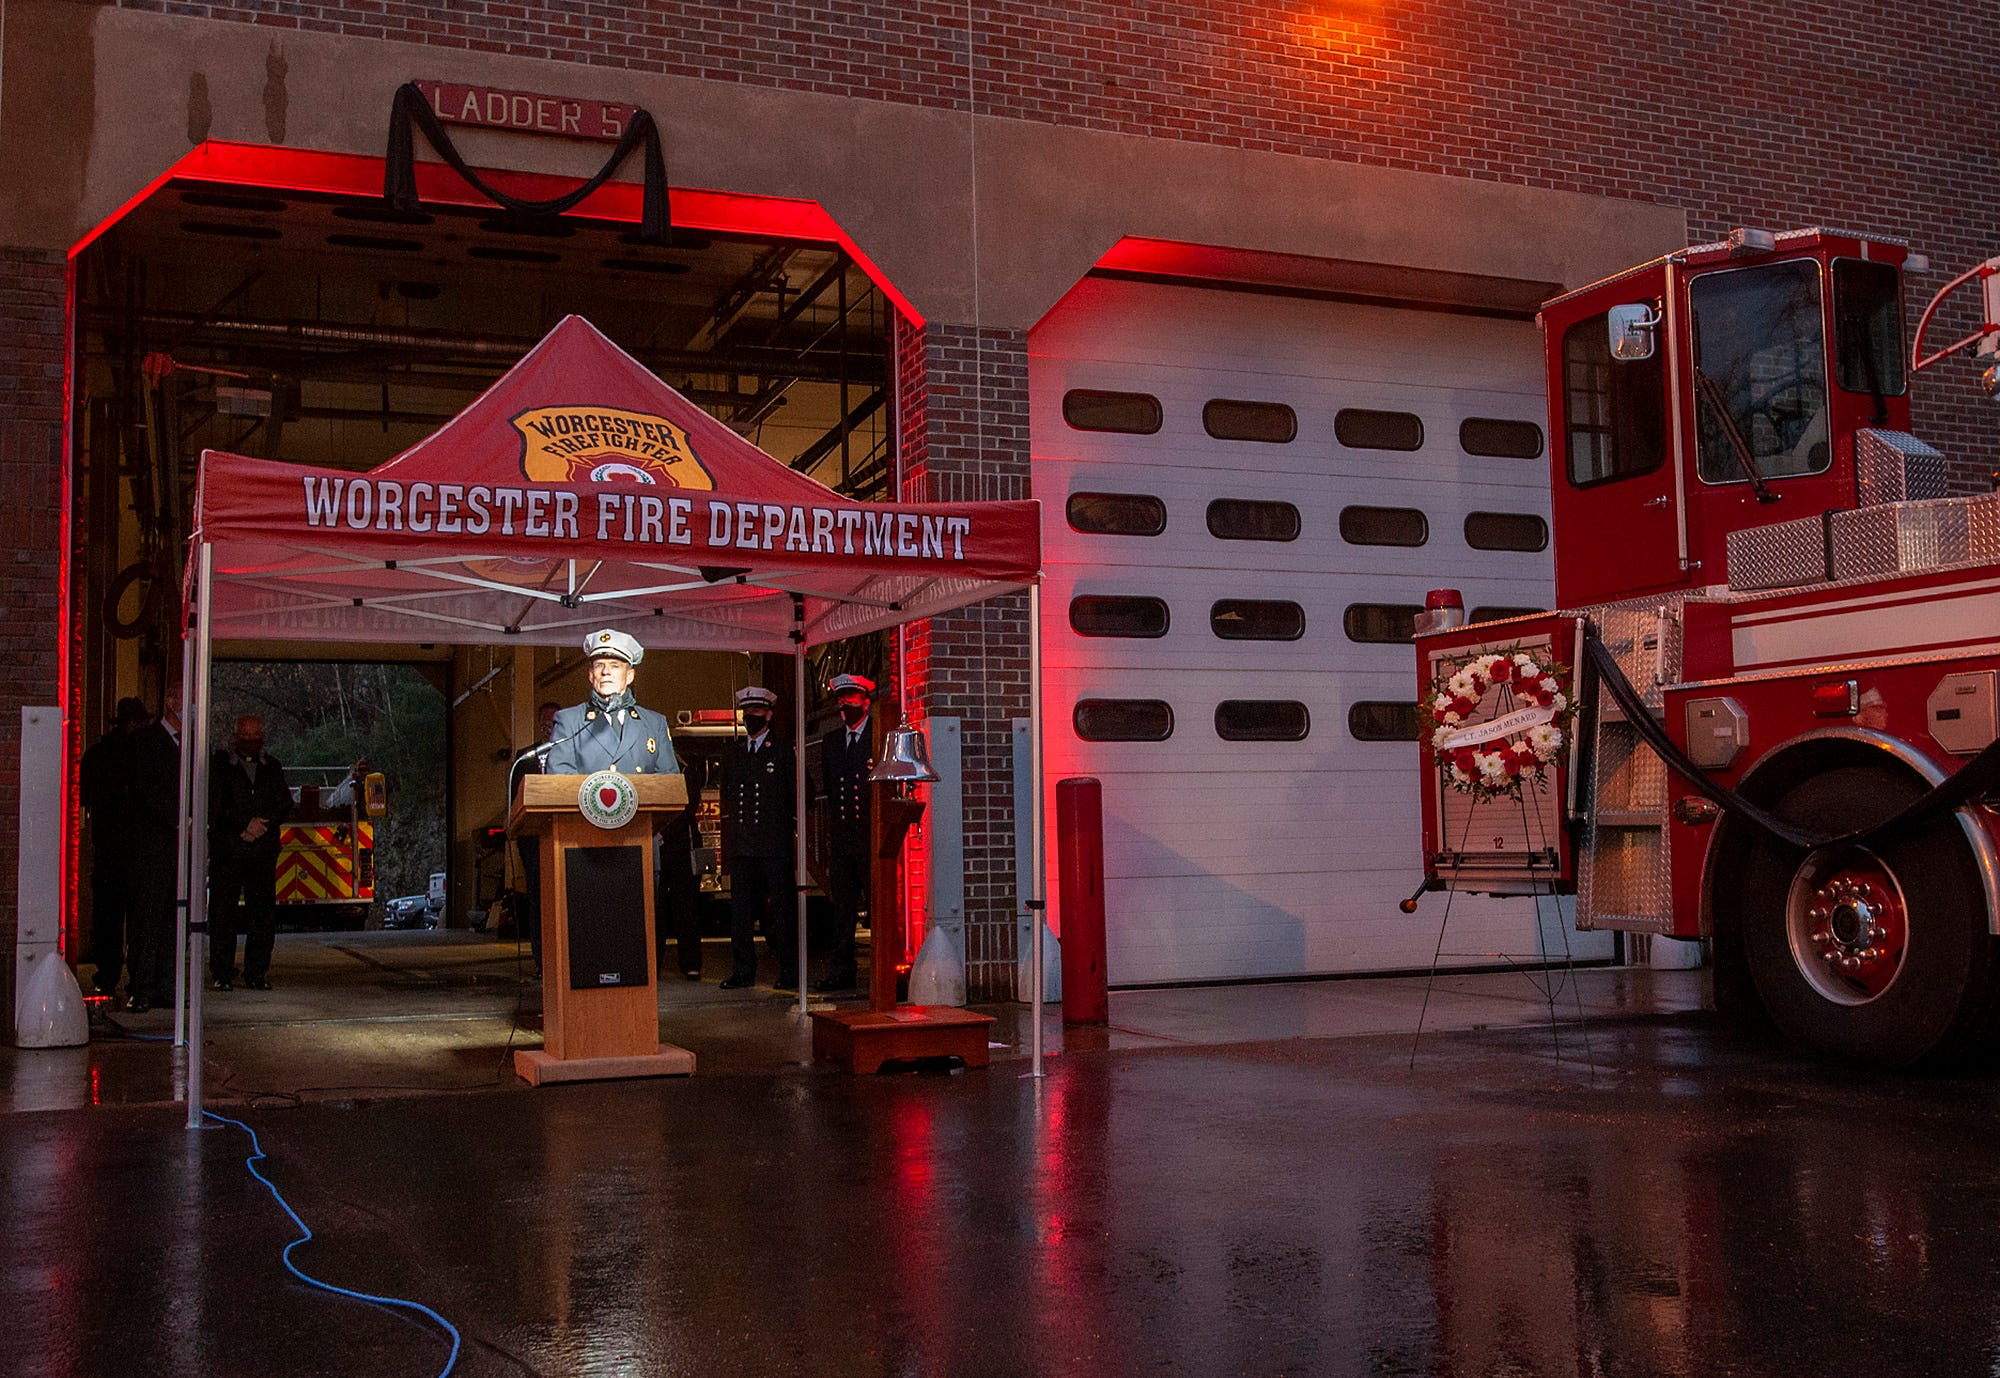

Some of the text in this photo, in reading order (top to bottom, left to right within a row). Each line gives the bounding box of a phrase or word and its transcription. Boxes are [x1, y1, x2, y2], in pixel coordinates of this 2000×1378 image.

[434, 87, 623, 138] LADDER 5
[526, 414, 681, 452] WORCESTER
[541, 432, 683, 466] FIREFIGHTER
[303, 475, 971, 560] WORCESTER FIRE DEPARTMENT
[1480, 725, 1503, 738] JASON
[1503, 712, 1537, 729] MENARD
[1493, 836, 1504, 850] 12
